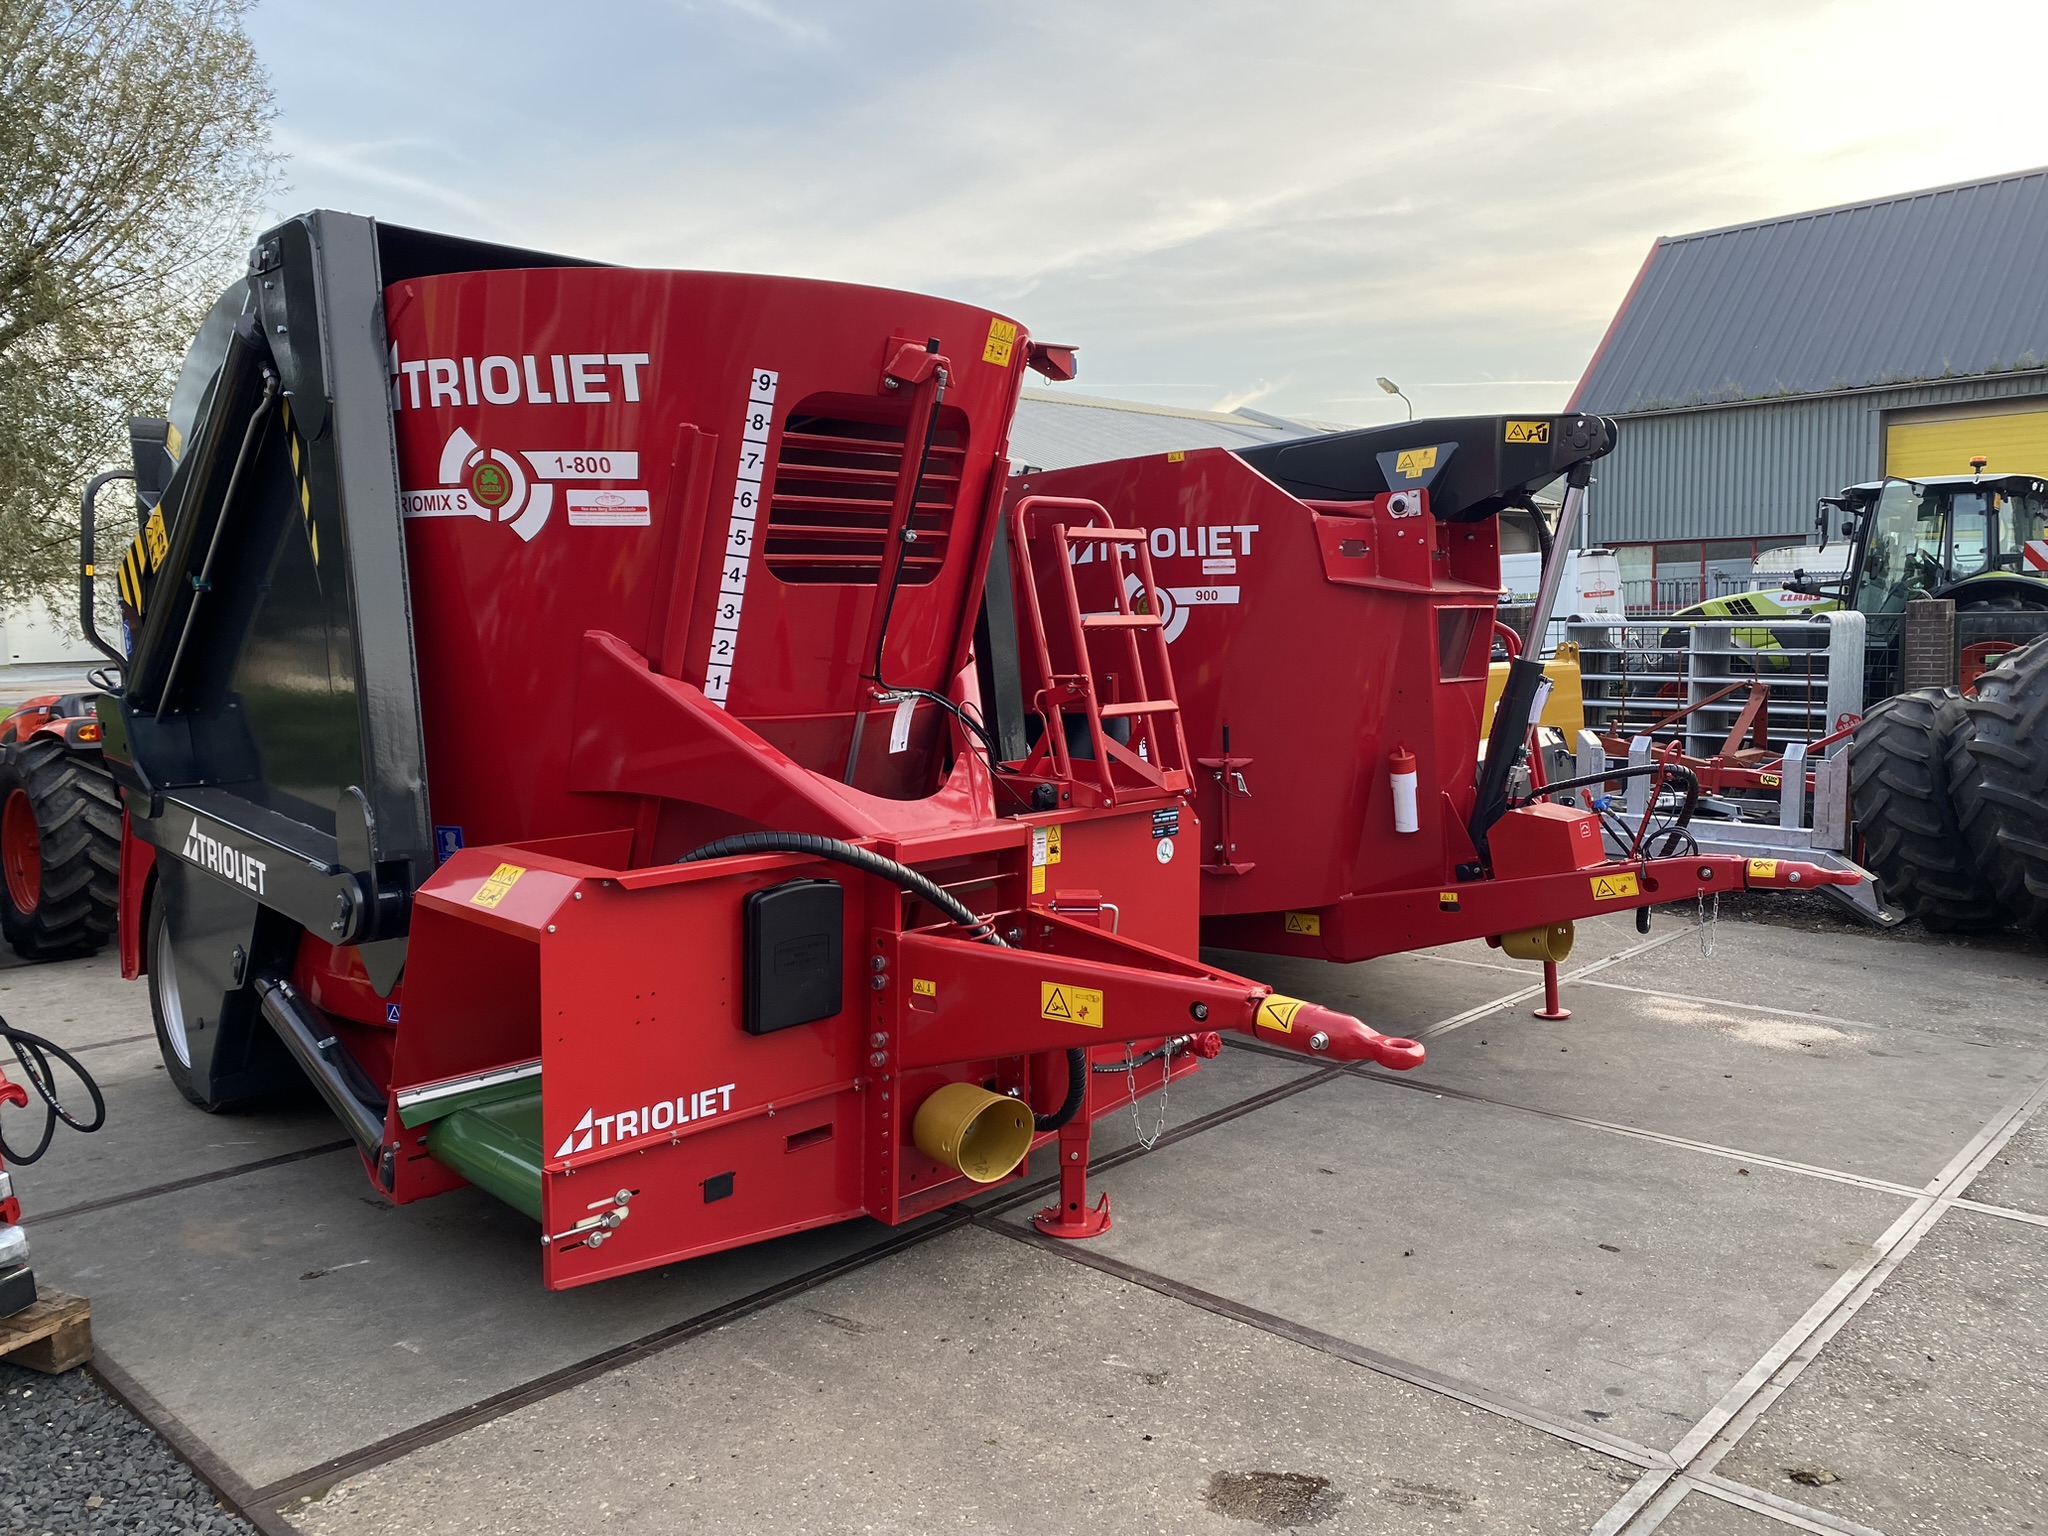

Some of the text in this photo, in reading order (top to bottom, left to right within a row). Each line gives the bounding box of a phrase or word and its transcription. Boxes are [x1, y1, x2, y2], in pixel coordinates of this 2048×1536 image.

[401, 353, 649, 409] TRIOLIET
[758, 373, 770, 391] 9
[752, 414, 764, 431] 8
[555, 456, 611, 473] 1-800
[747, 453, 759, 469] 7
[401, 494, 468, 513] RIOMIX S
[740, 491, 752, 508] 6
[734, 529, 746, 546] 5
[1097, 525, 1259, 561] OLIET
[728, 567, 740, 583] 4
[1195, 590, 1218, 601] 900
[1780, 593, 1821, 602] CLAAS
[723, 603, 735, 619] 3
[717, 640, 729, 655] 2
[713, 675, 721, 690] 1
[197, 833, 267, 895] TRIOLIET
[594, 1083, 736, 1146] TRIOLIET
